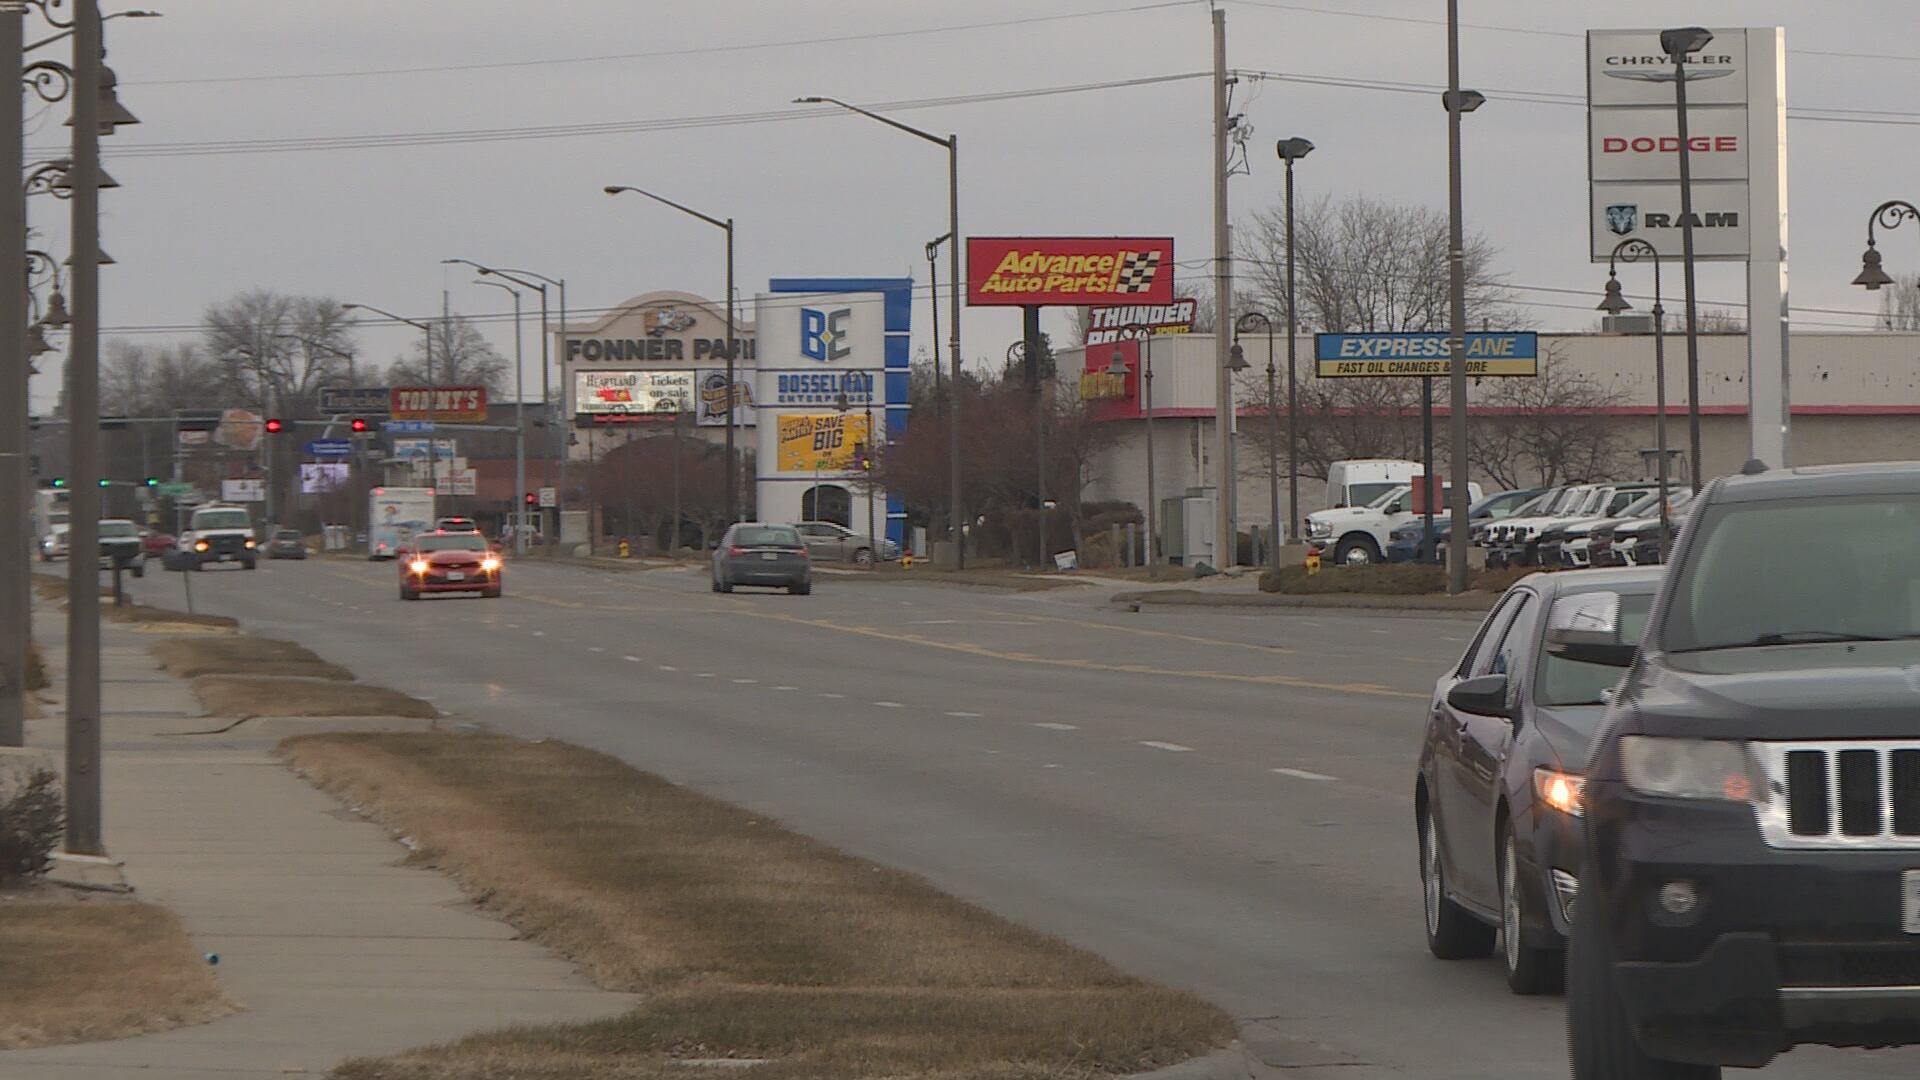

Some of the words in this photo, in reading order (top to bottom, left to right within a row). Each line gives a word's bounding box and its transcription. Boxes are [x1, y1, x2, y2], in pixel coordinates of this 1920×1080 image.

[1605, 55, 1733, 66] CHRYLER
[1603, 136, 1737, 153] DODGE
[1644, 212, 1739, 228] RAM
[995, 250, 1113, 274] Advance
[980, 274, 1043, 293] Auto
[1043, 274, 1109, 293] Parts
[1092, 301, 1194, 329] THUNDER
[565, 338, 685, 362] FONNER
[1340, 337, 1451, 357] EXPRESS
[1465, 336, 1517, 356] ANE
[1336, 361, 1363, 374] FAST
[1367, 361, 1385, 373] OIL
[1388, 361, 1440, 373] CHANGES
[1465, 361, 1488, 372] ORE
[651, 375, 689, 386] Tickets
[649, 387, 689, 398] on-sale
[815, 415, 845, 431] SAVE
[813, 429, 845, 451] BIG
